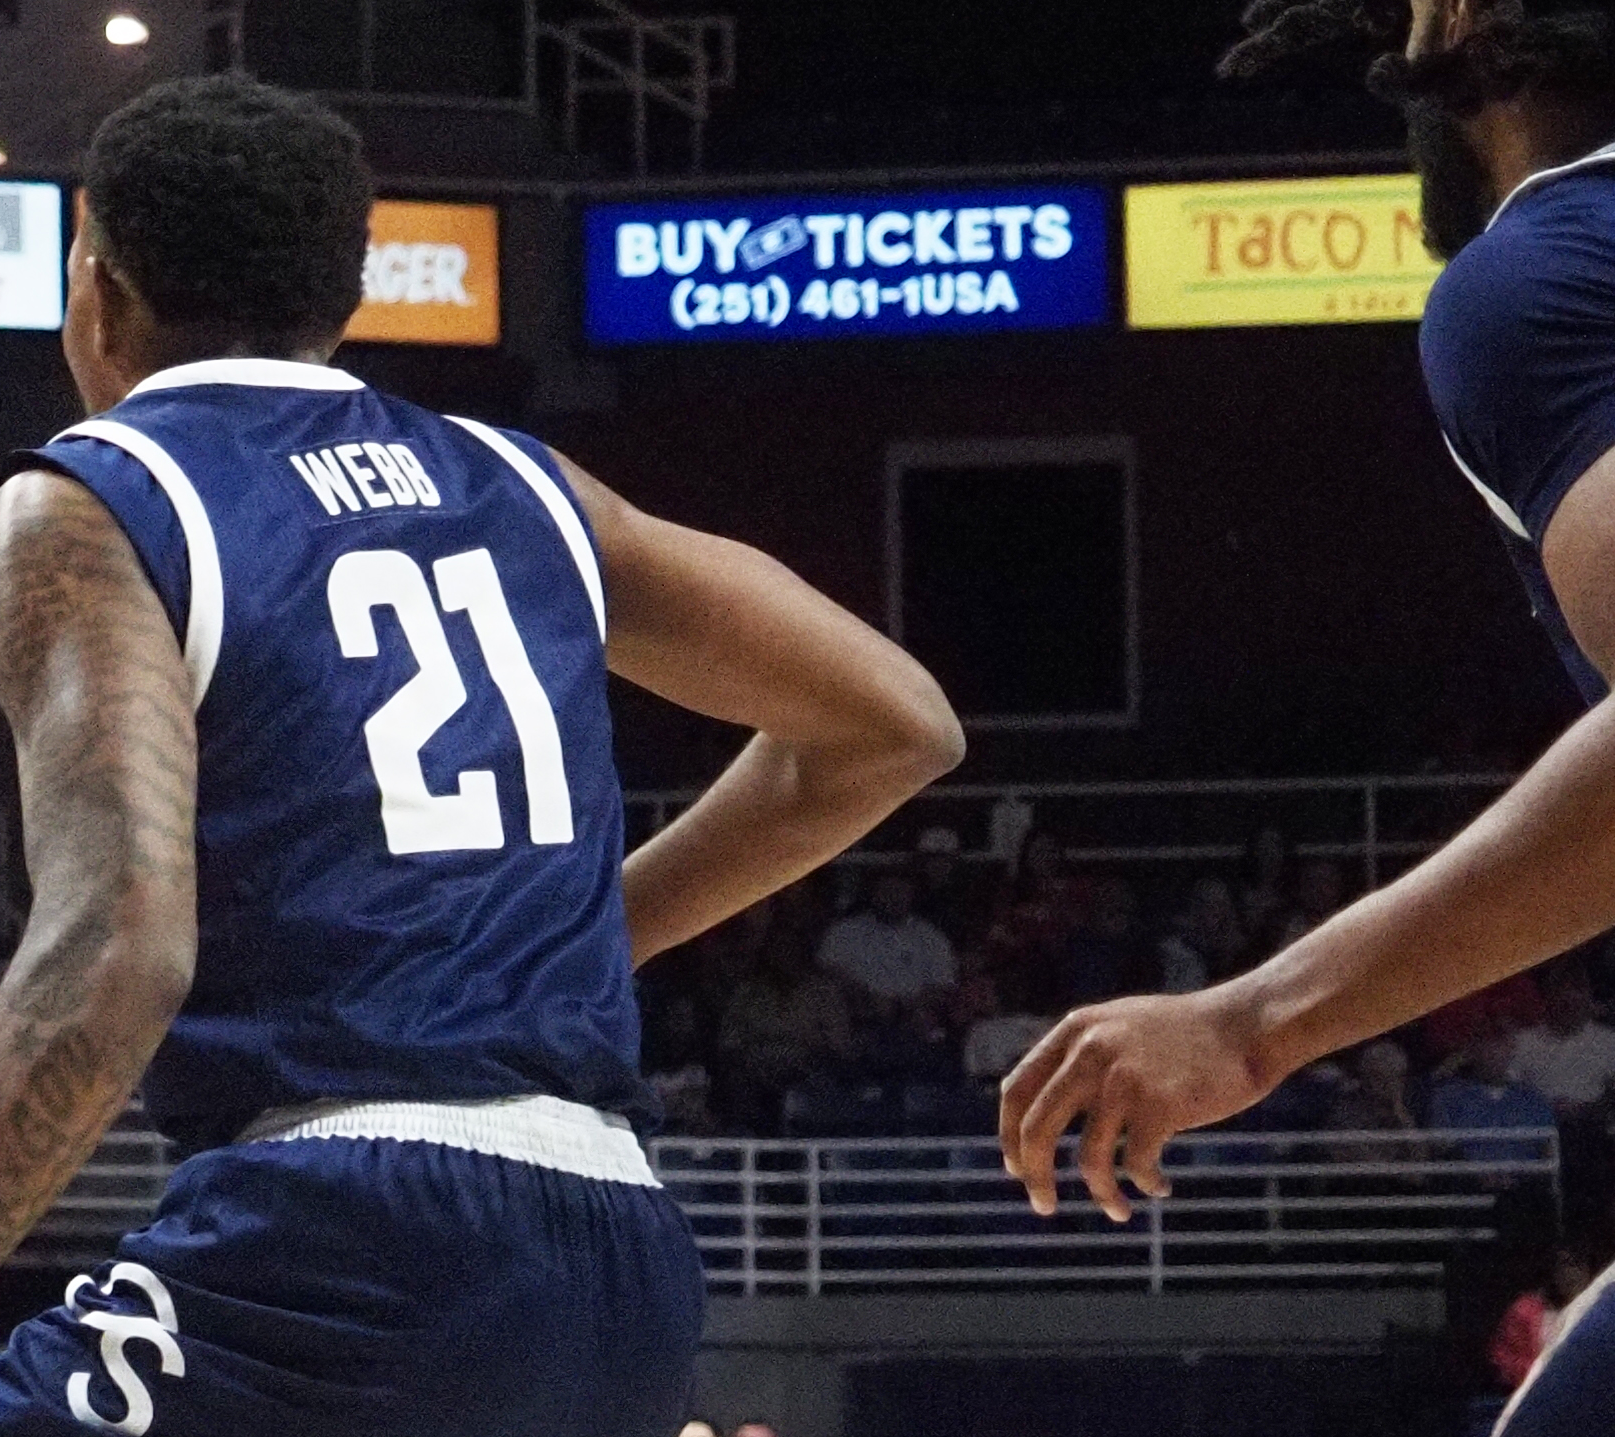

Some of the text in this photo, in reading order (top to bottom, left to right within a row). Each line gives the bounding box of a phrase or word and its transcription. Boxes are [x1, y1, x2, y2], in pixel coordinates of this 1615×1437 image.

[615, 203, 1073, 278] BUY TICKETS
[669, 269, 1020, 331] (251) 461-1USA
[289, 441, 442, 517] WEBB
[327, 547, 575, 856] 21
